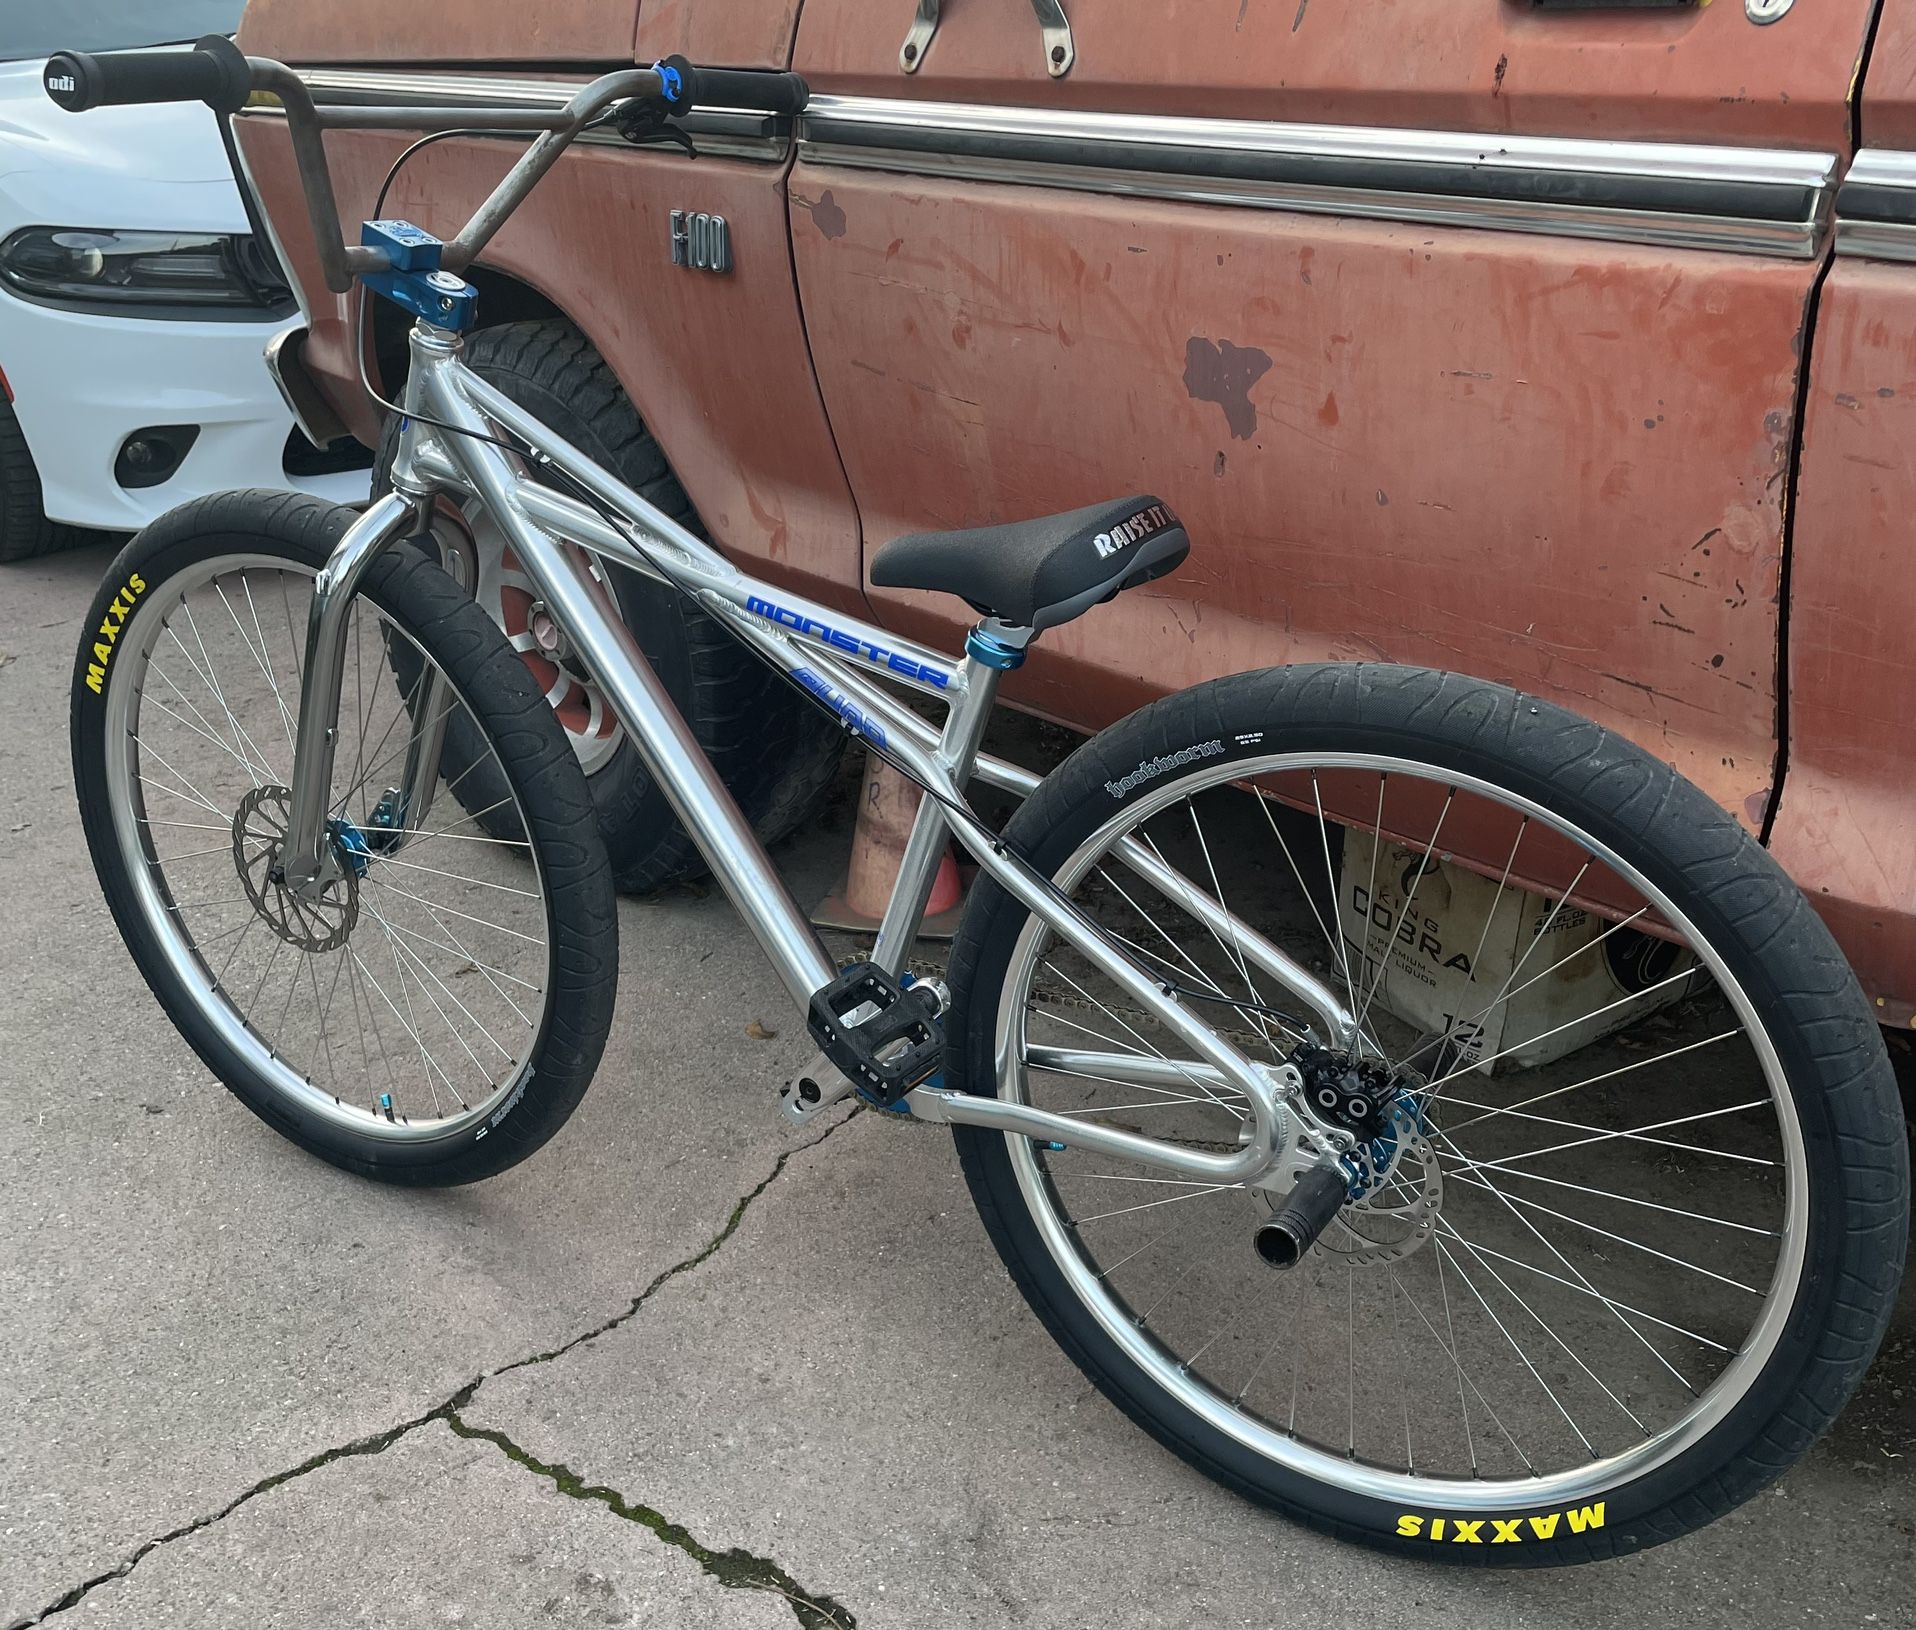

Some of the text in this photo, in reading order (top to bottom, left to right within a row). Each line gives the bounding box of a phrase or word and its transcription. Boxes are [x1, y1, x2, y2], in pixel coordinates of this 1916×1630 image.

[49, 75, 75, 91] odi
[1093, 512, 1153, 557] RAISE
[1147, 505, 1167, 528] IT
[86, 573, 146, 694] MAXXIS
[746, 594, 950, 690] MONSTER
[1379, 889, 1439, 933] KING
[1352, 885, 1477, 983] COBRA
[1395, 959, 1437, 987] LIQUOR
[1442, 1012, 1485, 1048] 12
[1396, 1501, 1606, 1544] MAXXIS
